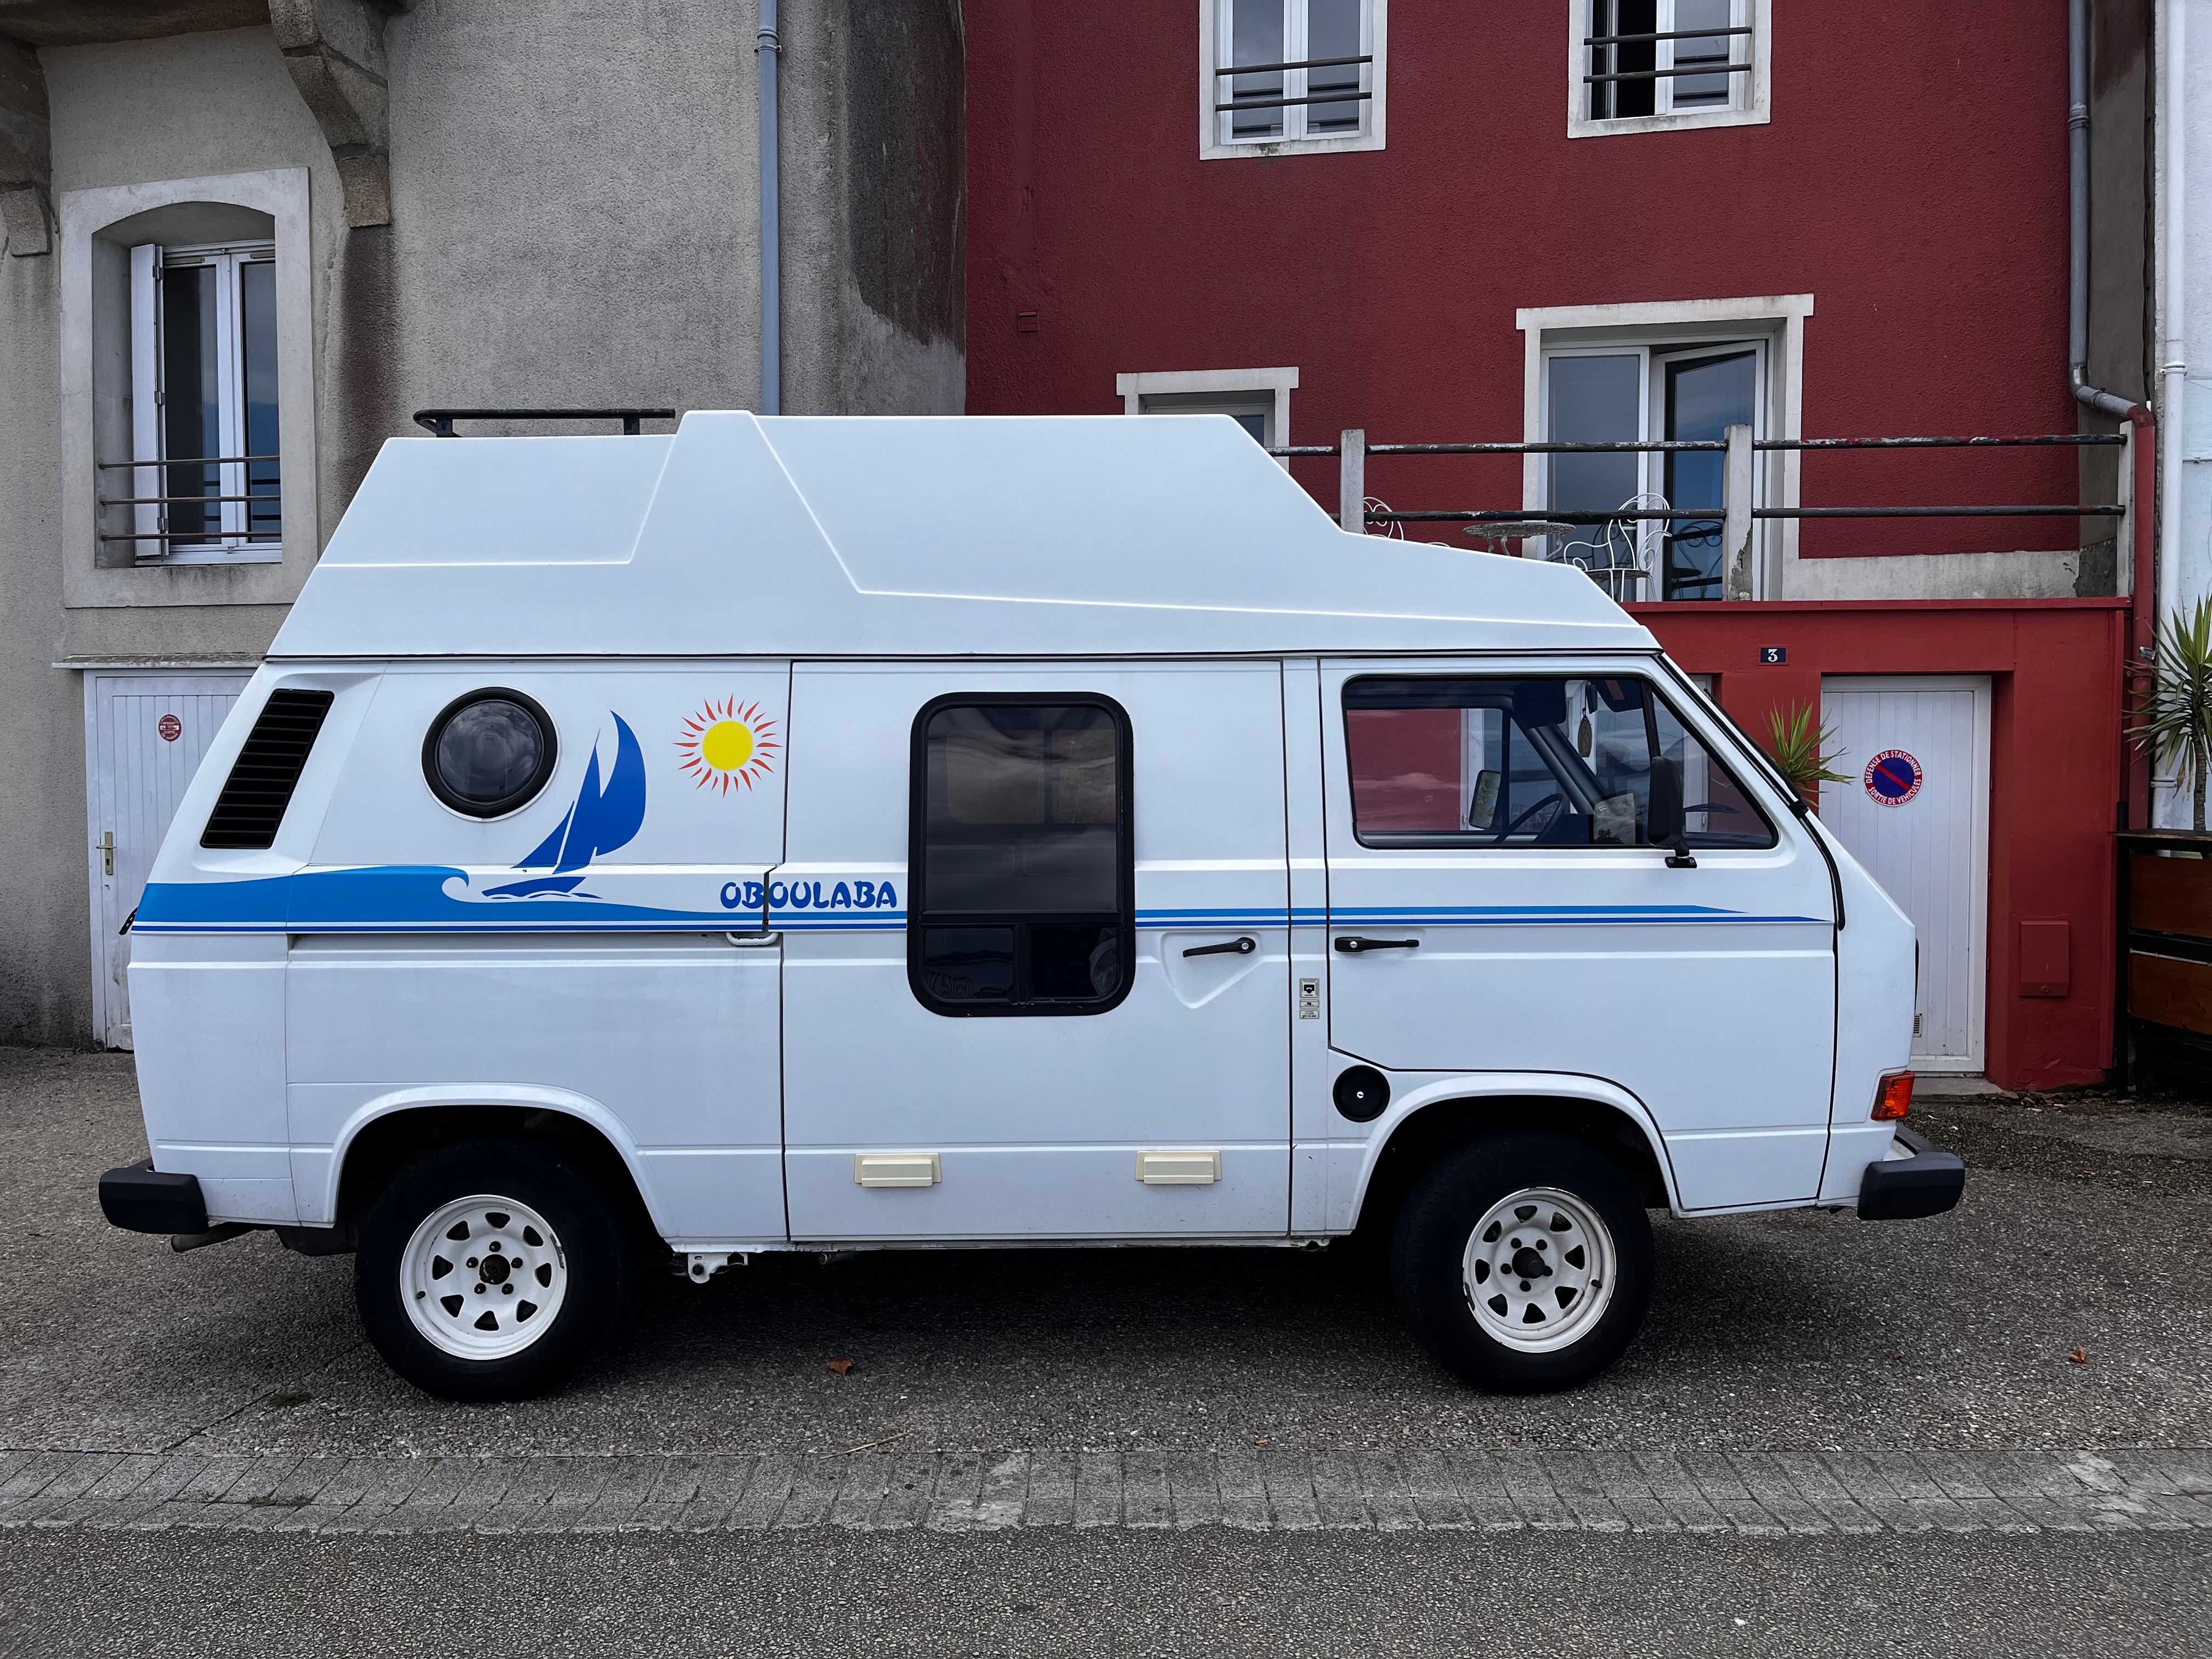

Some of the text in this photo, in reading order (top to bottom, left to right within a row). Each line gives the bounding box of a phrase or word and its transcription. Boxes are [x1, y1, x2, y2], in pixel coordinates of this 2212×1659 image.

[1768, 648, 1778, 662] 3
[1865, 751, 1921, 783] DEFENSE DE STATIONNER
[1868, 787, 1888, 804] SORTIE
[1897, 778, 1921, 804] VEHICULES
[720, 881, 898, 909] OBOULABA
